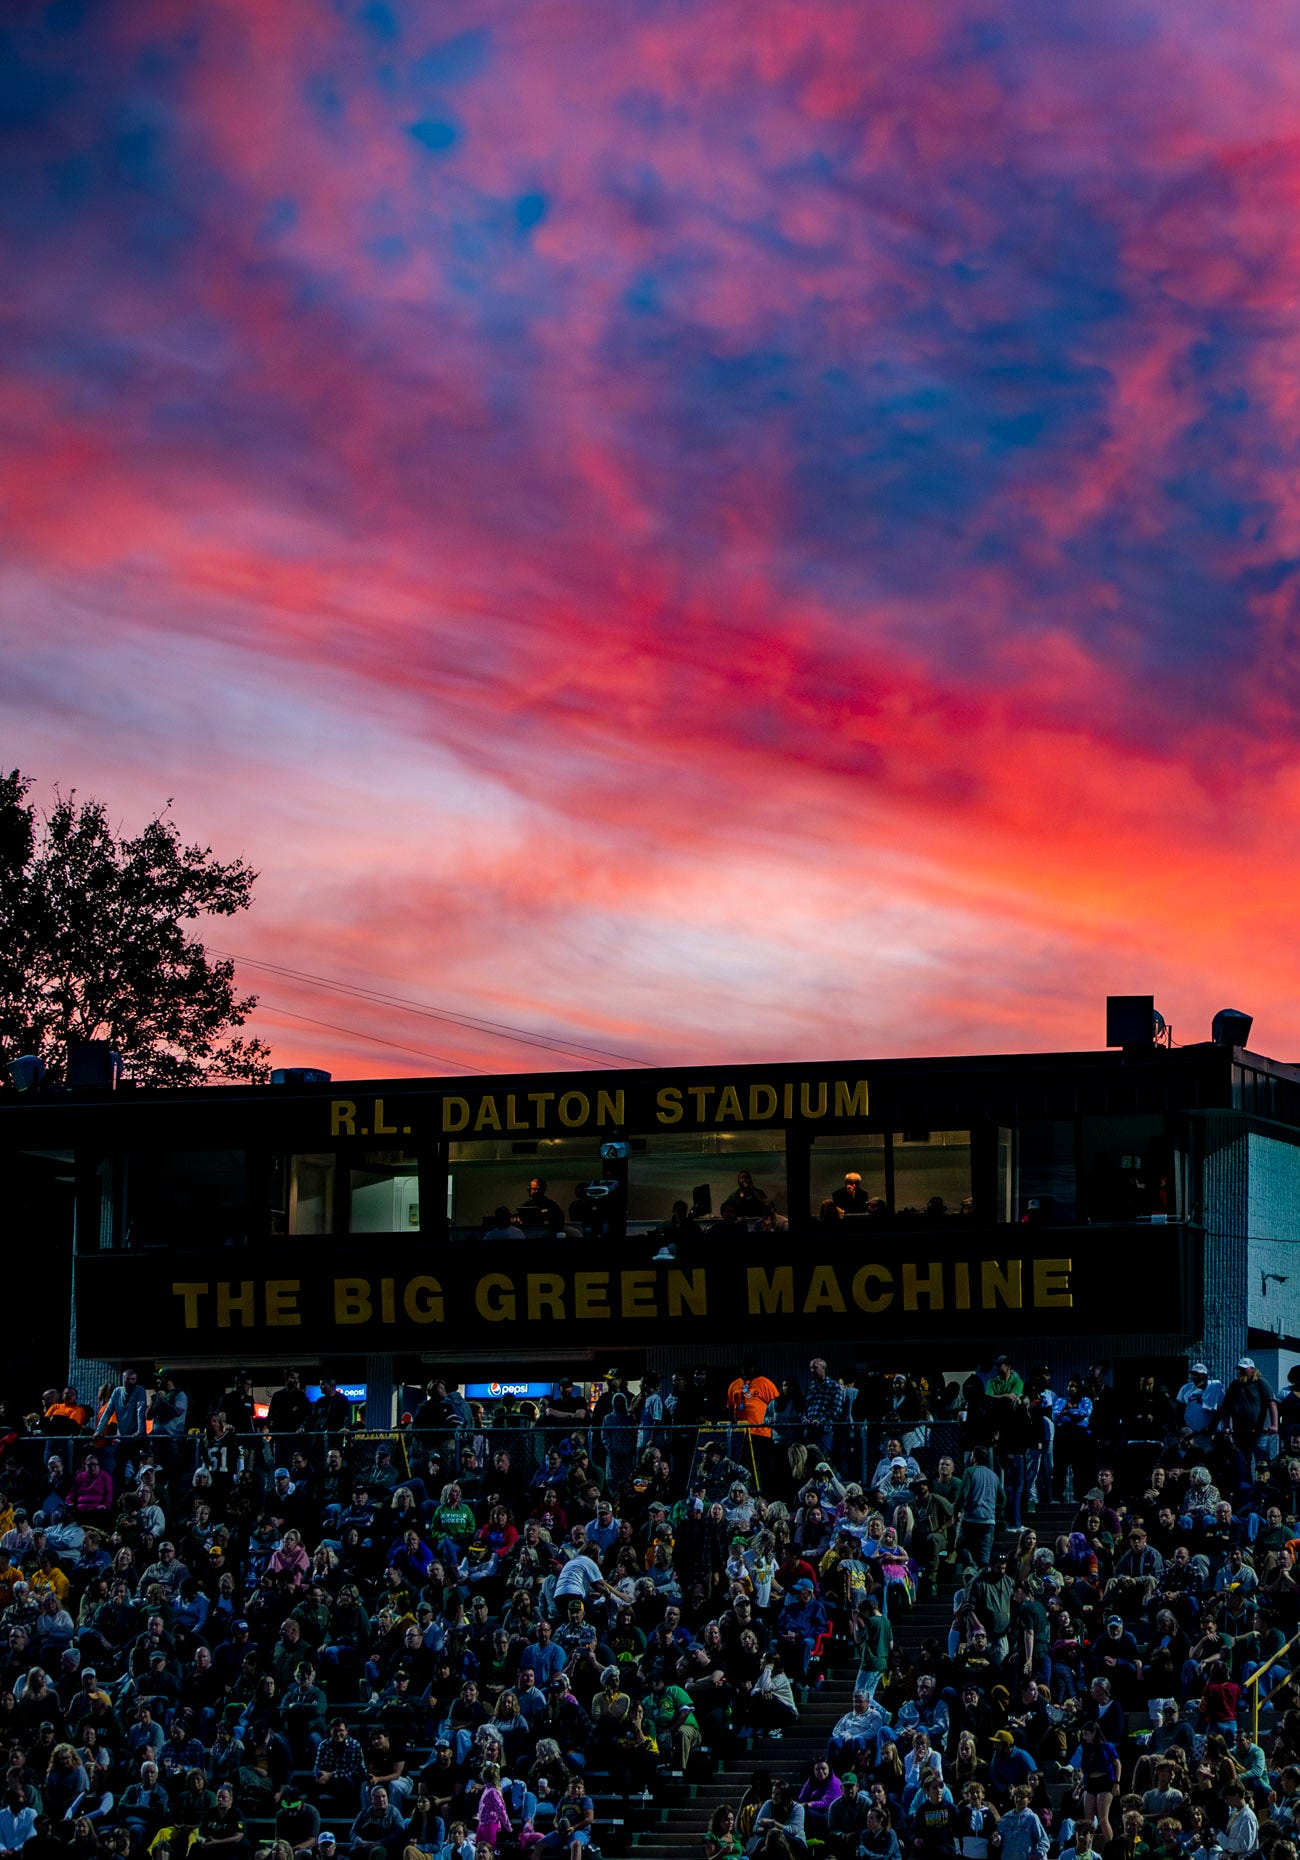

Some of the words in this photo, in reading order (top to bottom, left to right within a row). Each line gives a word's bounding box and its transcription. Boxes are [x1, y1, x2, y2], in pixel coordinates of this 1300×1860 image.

[331, 1100, 411, 1136] R.L.
[441, 1090, 625, 1132] DALTON
[656, 1080, 870, 1125] STADIUM
[172, 1279, 303, 1329] THE
[333, 1274, 445, 1325] BIG
[474, 1268, 708, 1322] GREEN
[746, 1258, 1074, 1315] MACHINE
[502, 1383, 528, 1395] pepsi
[207, 1446, 228, 1472] 51
